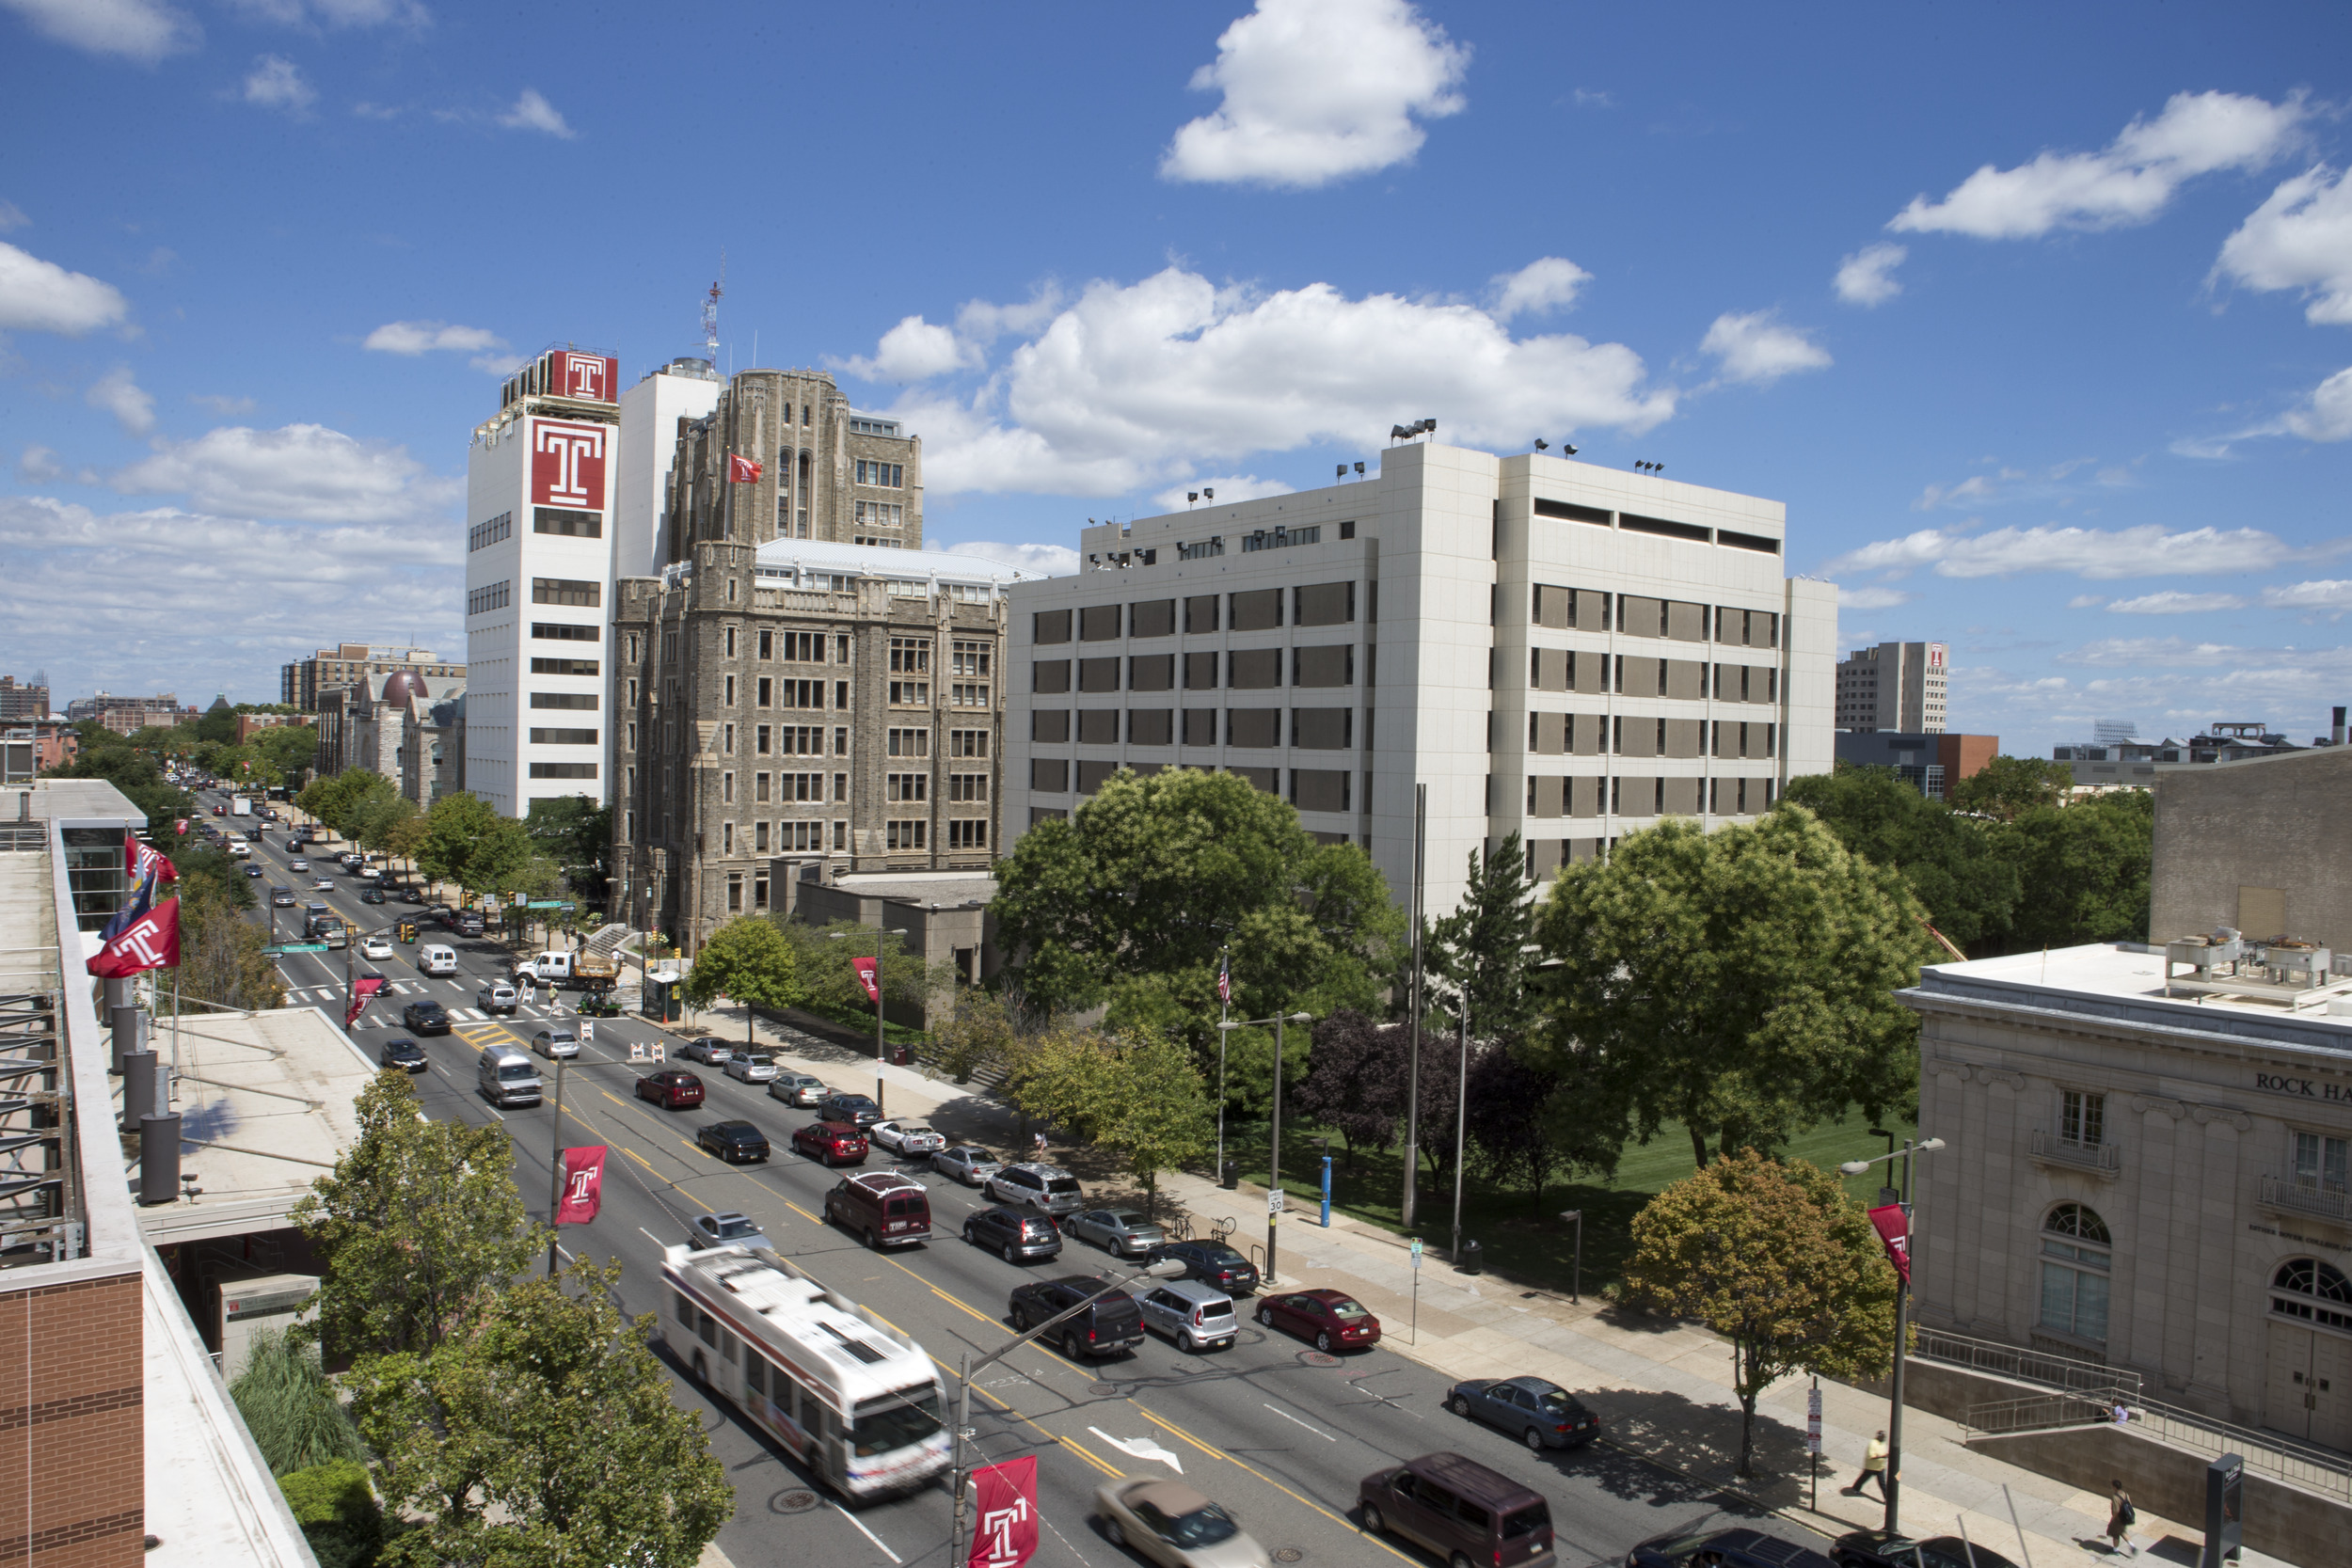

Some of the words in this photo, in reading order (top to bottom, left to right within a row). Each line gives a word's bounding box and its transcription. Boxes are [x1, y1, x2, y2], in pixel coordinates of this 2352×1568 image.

[569, 357, 602, 398] T
[537, 424, 602, 506] T
[109, 919, 167, 966] T
[2255, 1073, 2315, 1097] ROCK
[570, 1166, 599, 1204] T
[1270, 1201, 1281, 1211] 30
[984, 1497, 1027, 1568] T
